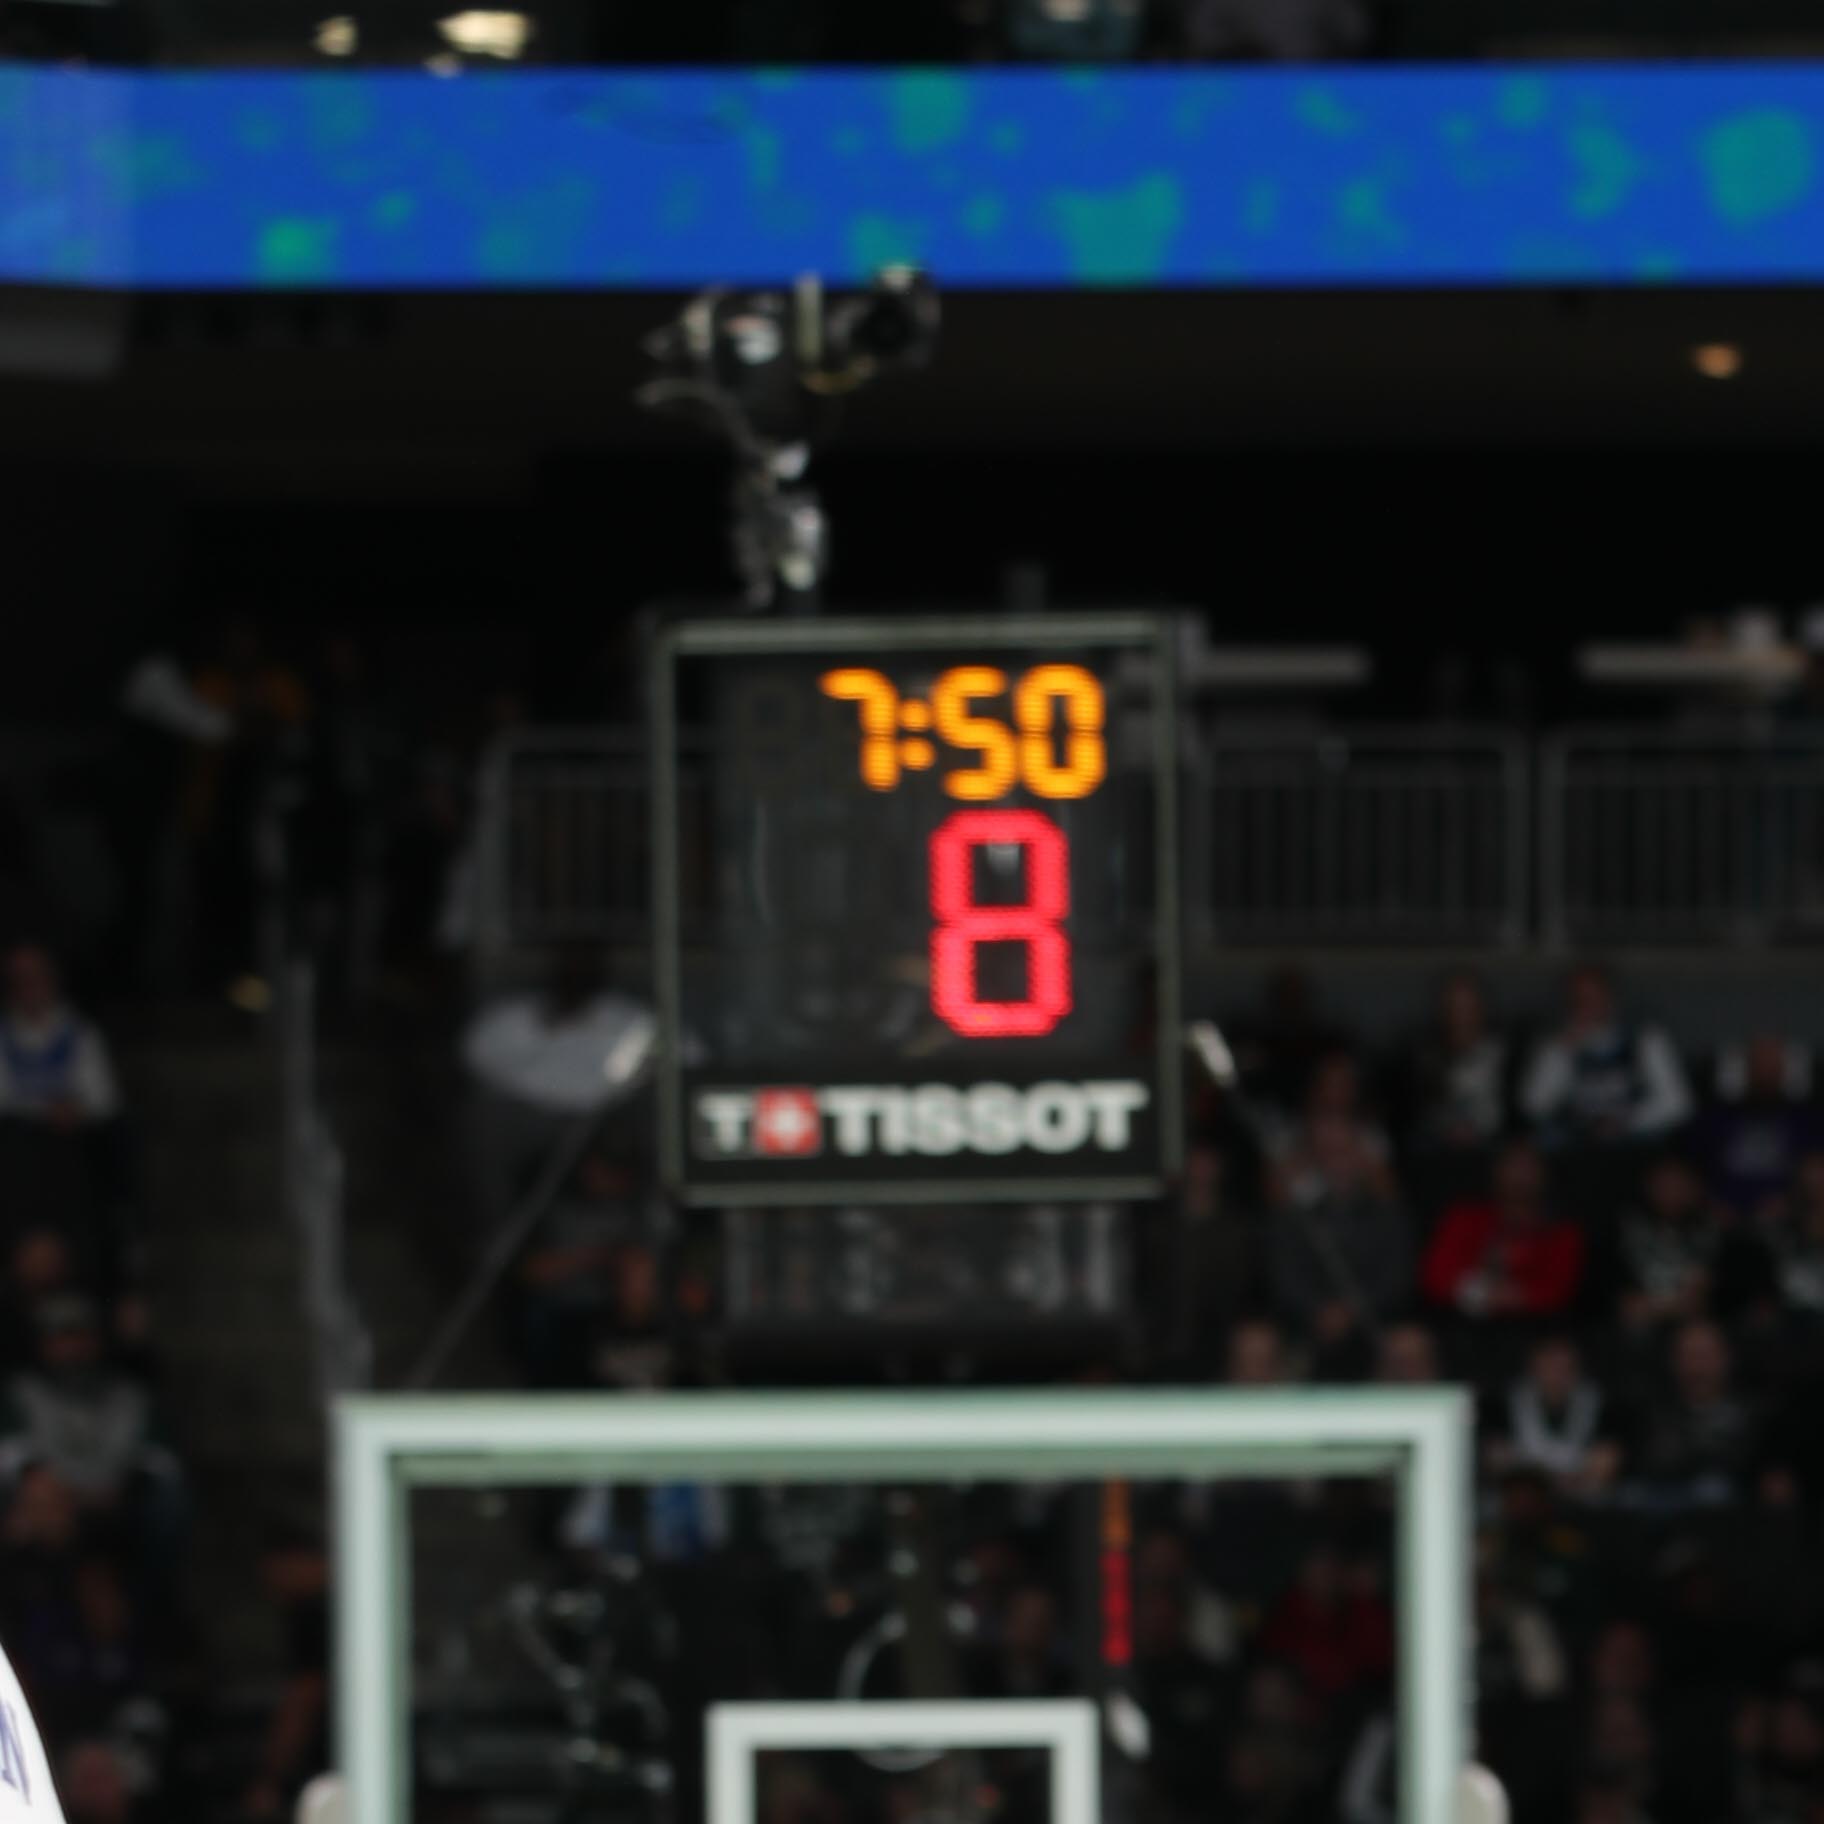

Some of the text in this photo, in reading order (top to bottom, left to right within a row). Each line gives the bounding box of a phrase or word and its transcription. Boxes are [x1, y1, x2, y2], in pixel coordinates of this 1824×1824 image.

[820, 664, 1106, 801] 7:50
[929, 808, 1073, 1038] 8
[820, 1079, 1148, 1158] TISSOT
